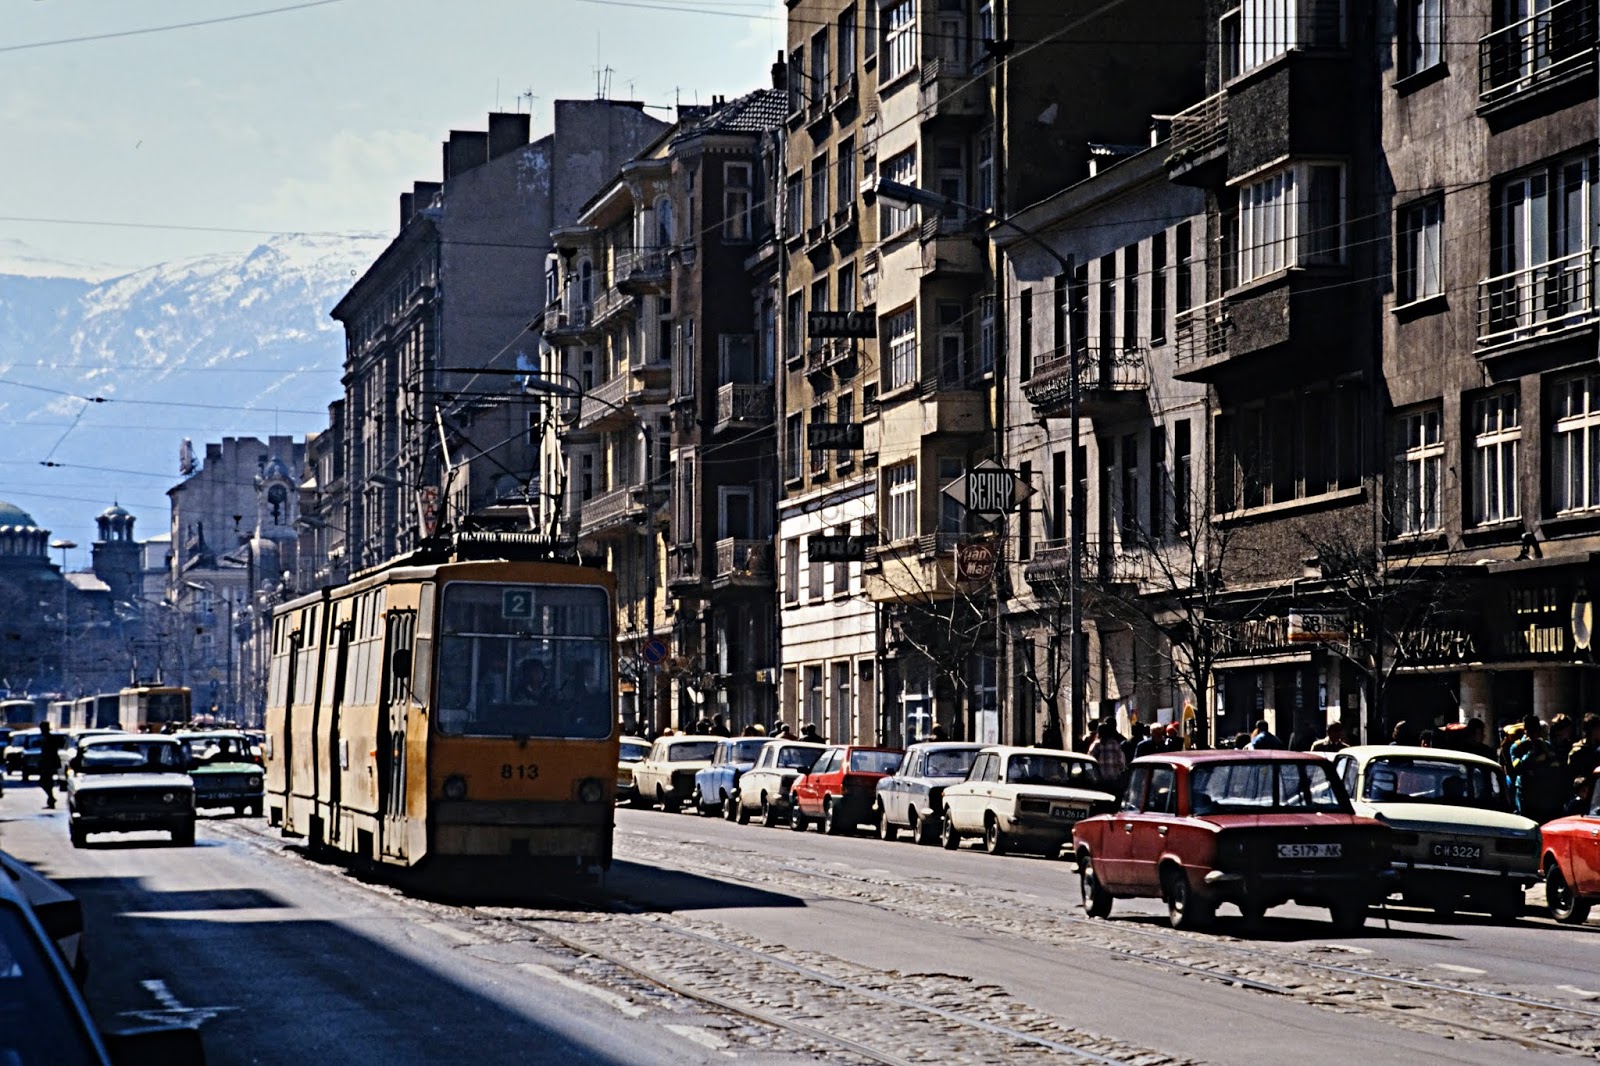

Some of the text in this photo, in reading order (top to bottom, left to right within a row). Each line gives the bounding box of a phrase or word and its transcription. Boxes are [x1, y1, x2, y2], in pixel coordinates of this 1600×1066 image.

[970, 473, 1013, 510] ВЕЛУР
[512, 595, 525, 612] 2
[501, 764, 539, 780] 813
